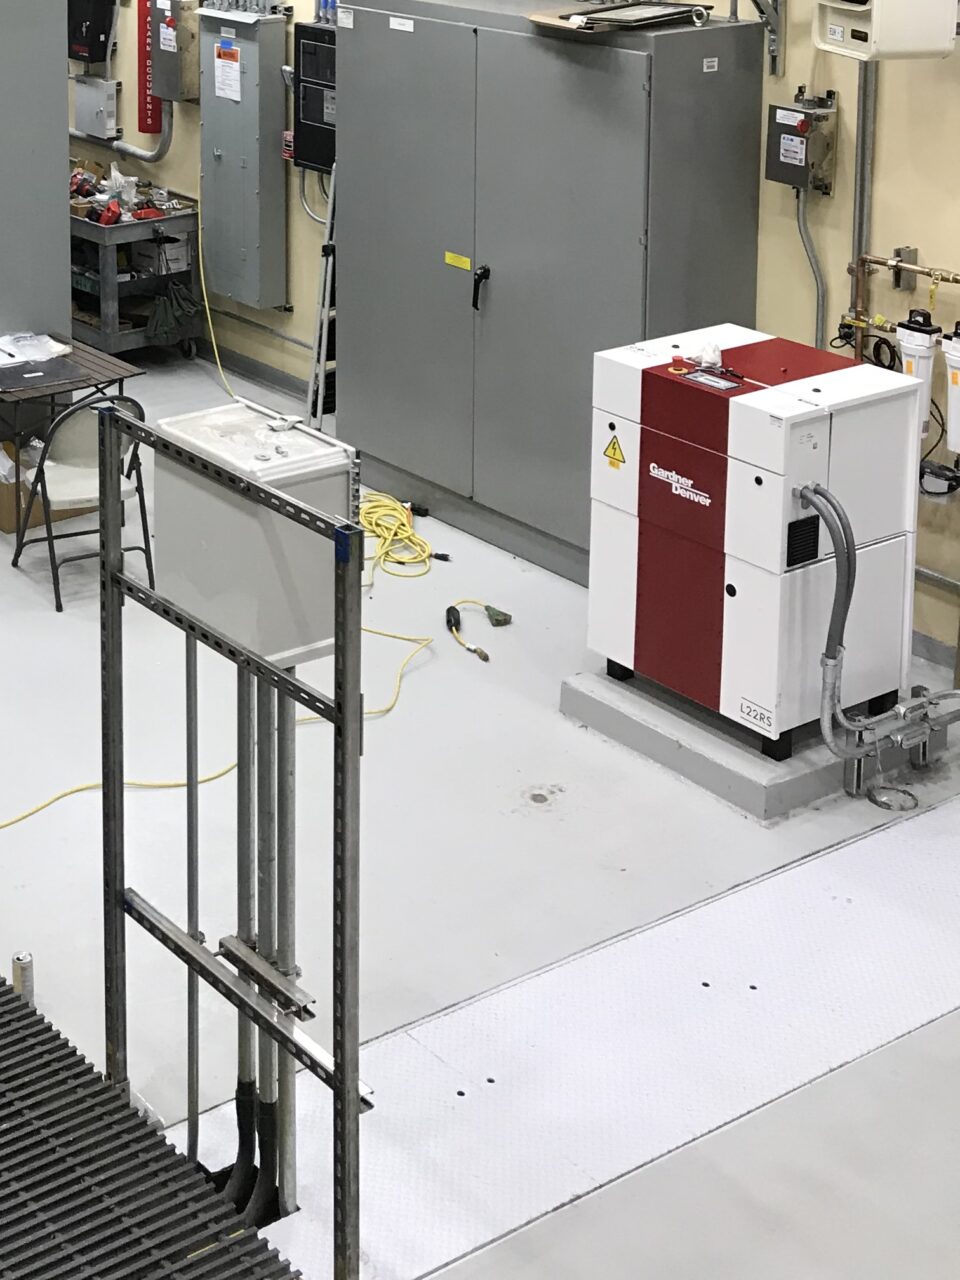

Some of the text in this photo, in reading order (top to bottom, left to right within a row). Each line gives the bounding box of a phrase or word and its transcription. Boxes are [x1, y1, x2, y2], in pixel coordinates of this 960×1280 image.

[649, 462, 694, 487] Gardner
[672, 482, 712, 507] Denver
[740, 702, 773, 728] L22RS
